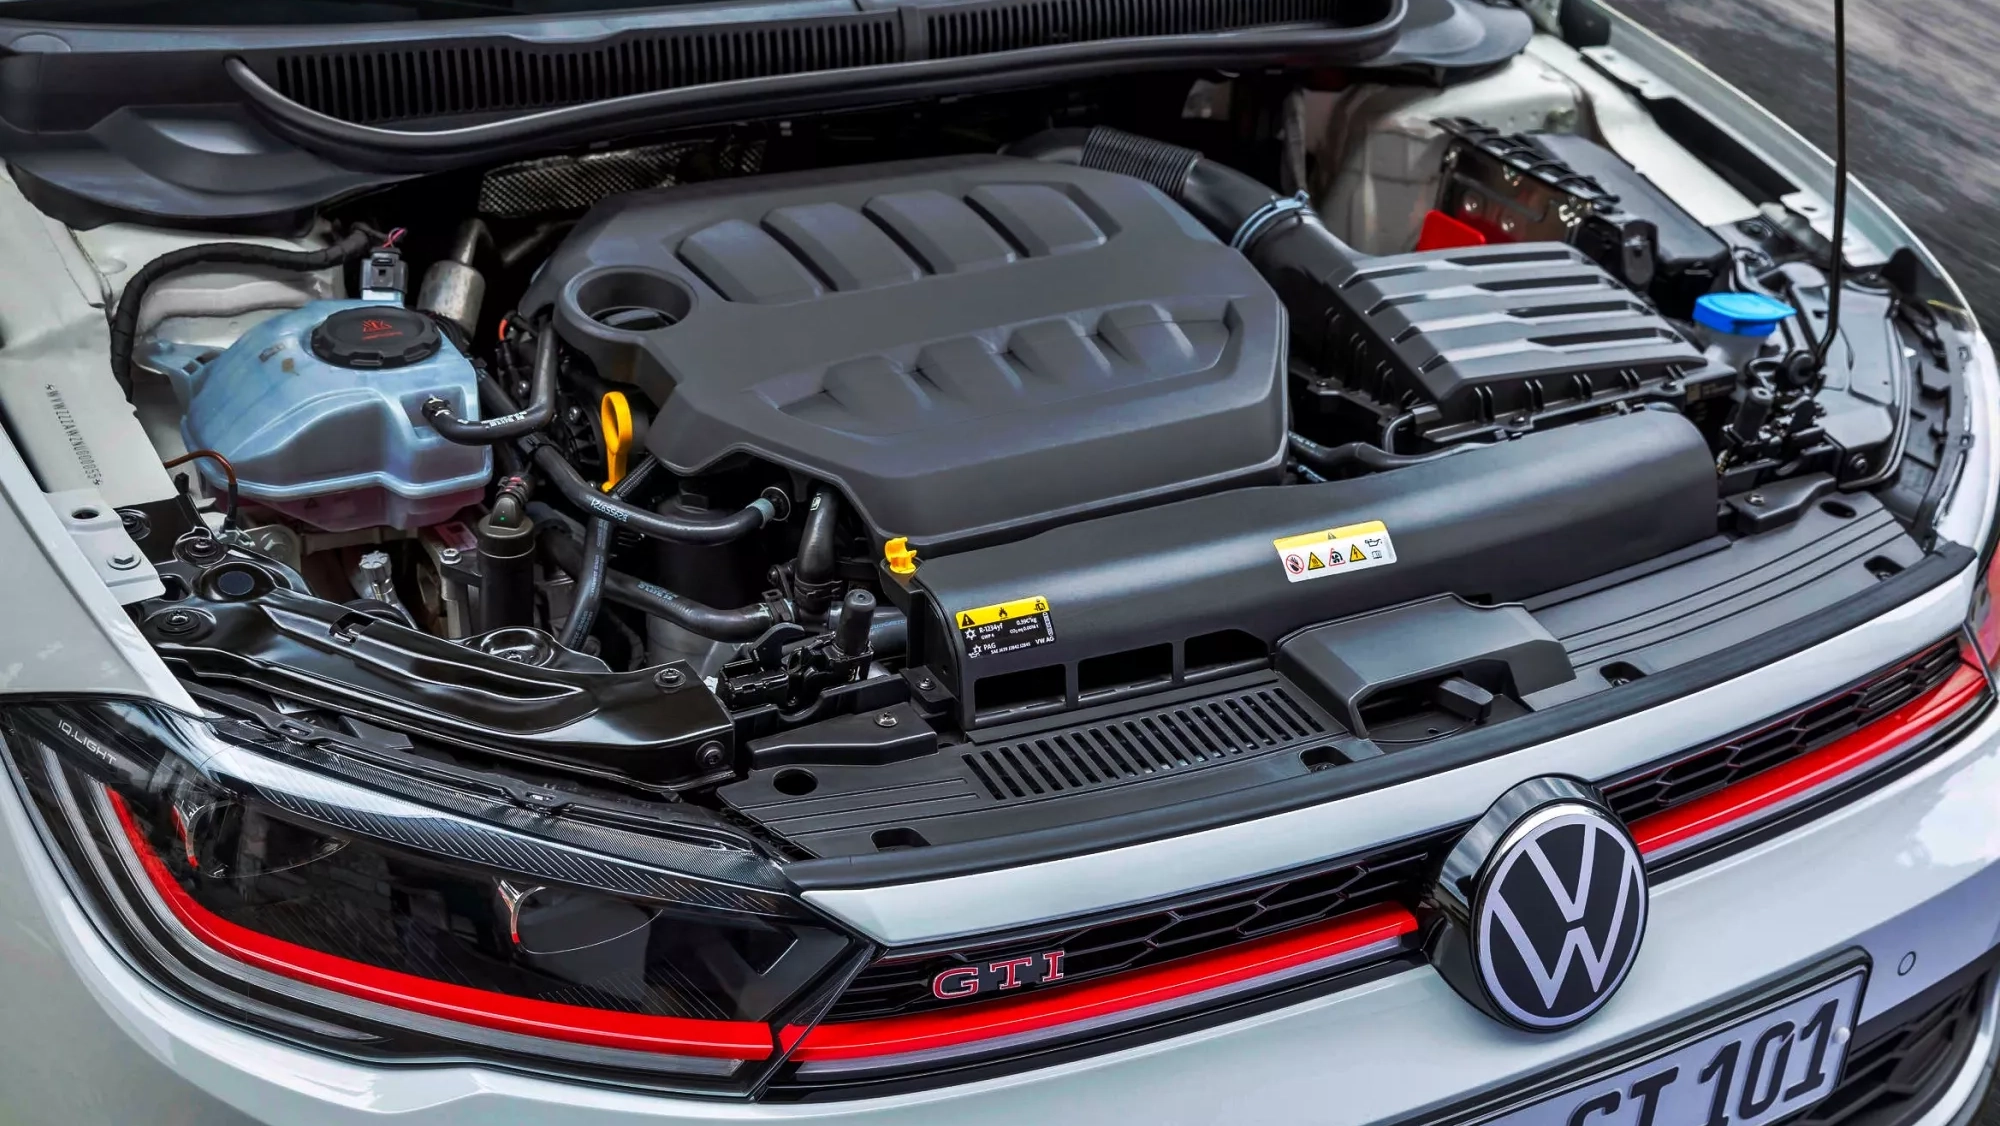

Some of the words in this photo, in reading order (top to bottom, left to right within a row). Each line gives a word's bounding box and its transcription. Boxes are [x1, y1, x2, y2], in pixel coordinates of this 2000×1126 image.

[978, 623, 1003, 633] R-1234yf
[1035, 637, 1045, 645] VW
[983, 642, 996, 651] PAG
[58, 719, 117, 765] IQ.LIGHT
[932, 950, 1065, 1000] GTI
[1699, 998, 1840, 1126] 101
